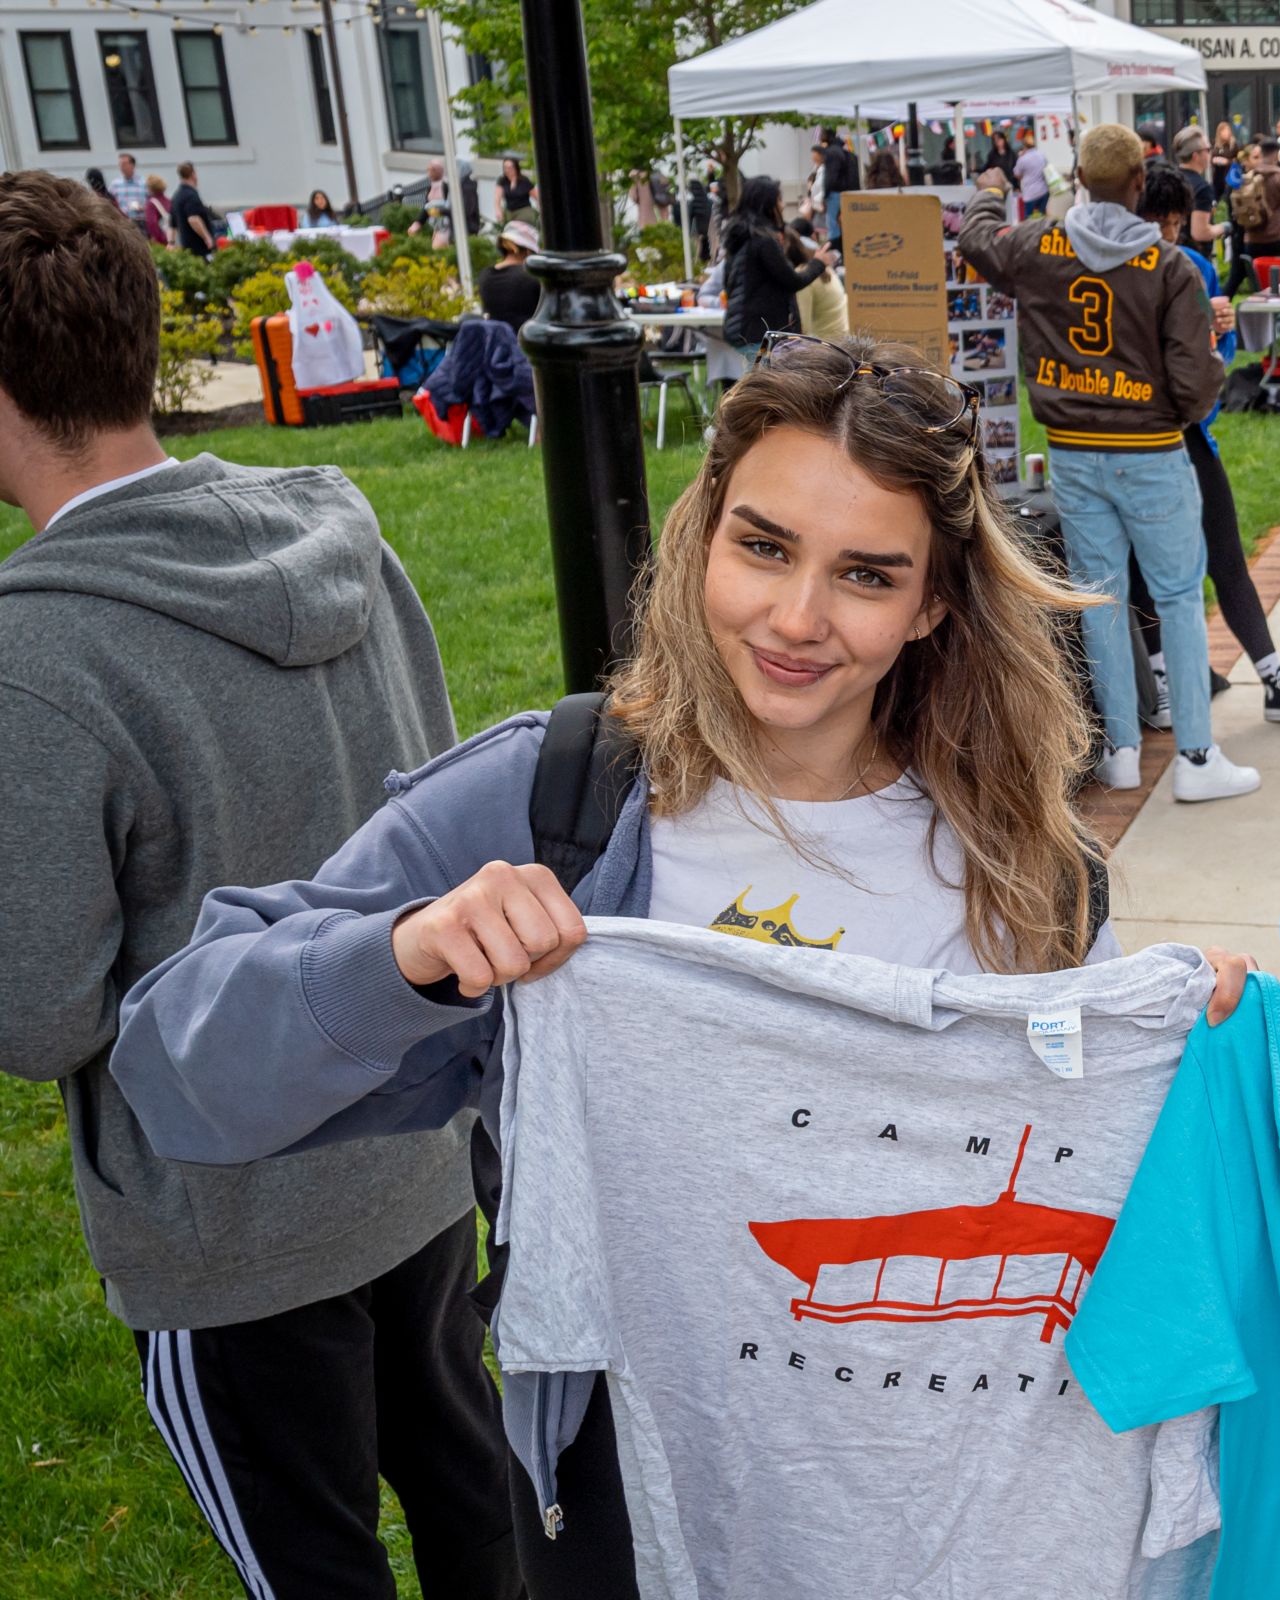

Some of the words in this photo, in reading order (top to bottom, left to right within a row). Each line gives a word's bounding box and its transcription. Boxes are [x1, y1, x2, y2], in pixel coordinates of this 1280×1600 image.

[1240, 38, 1256, 58] A.
[1069, 276, 1113, 356] 3
[1060, 363, 1110, 396] Double
[1112, 371, 1153, 401] Dose
[1031, 1020, 1066, 1032] PORT
[791, 1109, 1074, 1163] CAMP
[739, 1342, 1070, 1396] RECREATI
